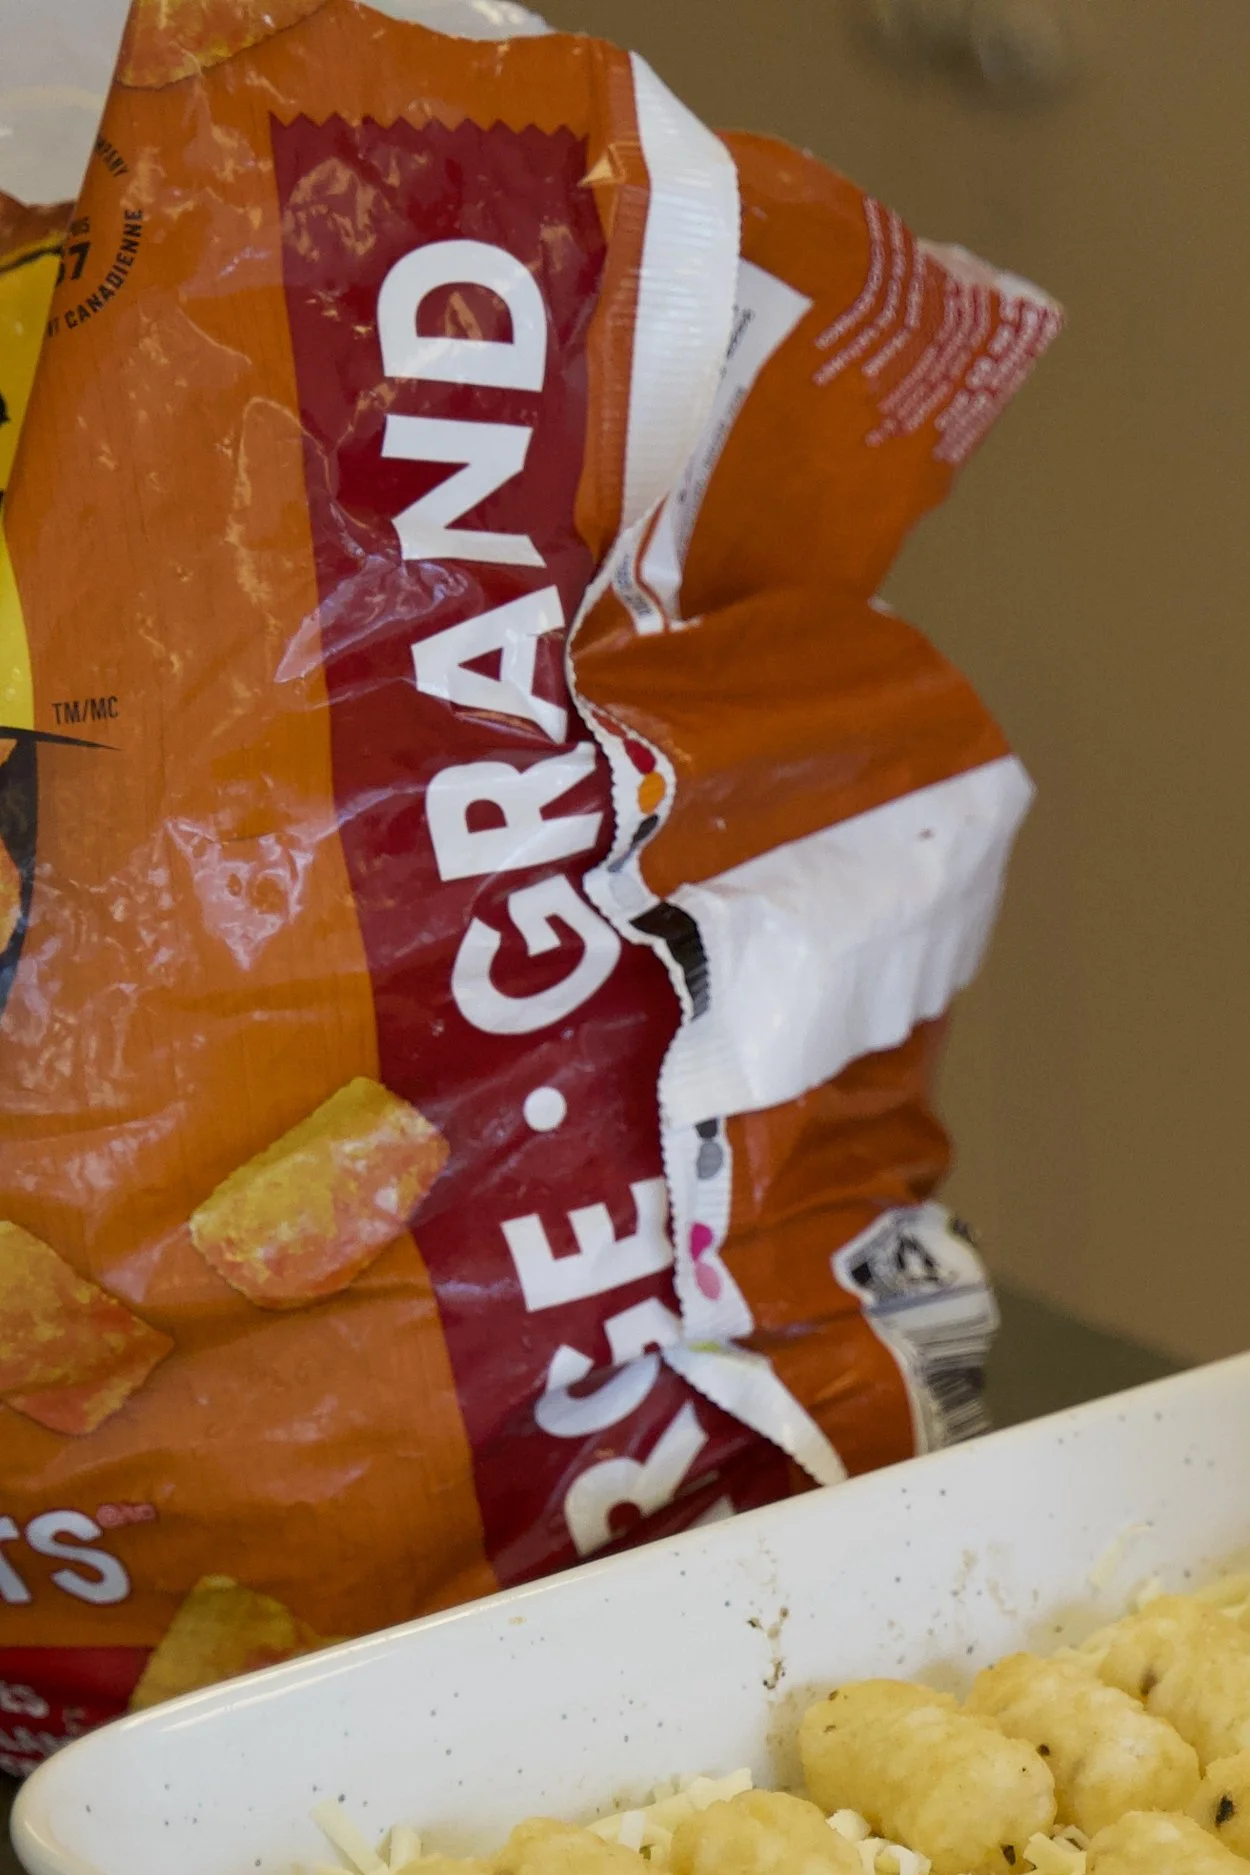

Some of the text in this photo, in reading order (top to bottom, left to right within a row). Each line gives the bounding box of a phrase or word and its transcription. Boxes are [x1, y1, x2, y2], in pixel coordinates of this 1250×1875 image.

[64, 208, 143, 330] CANADIENNE
[52, 696, 119, 725] TM/MC
[377, 239, 736, 1556] RGE GRAND
